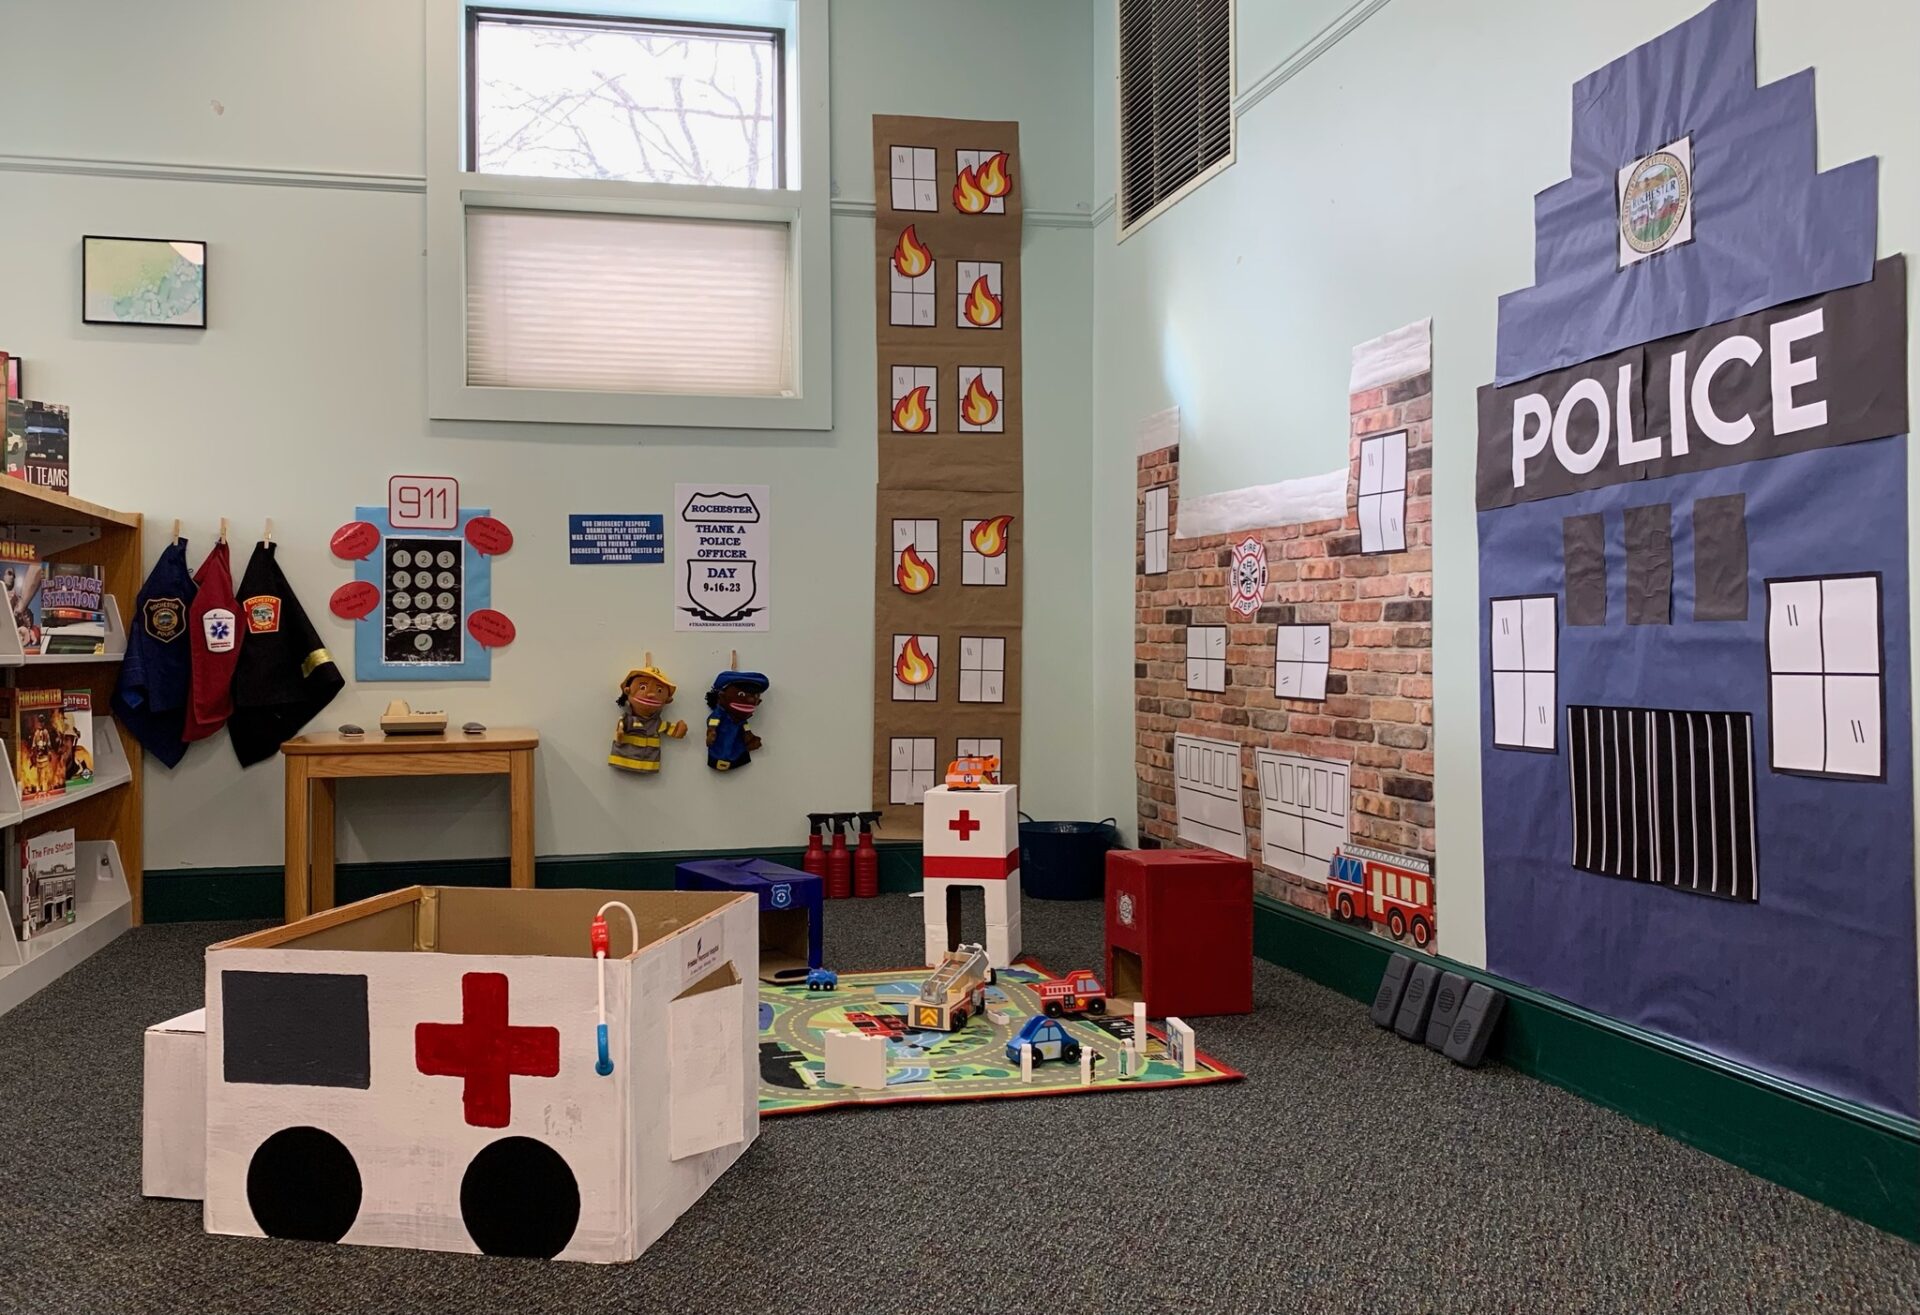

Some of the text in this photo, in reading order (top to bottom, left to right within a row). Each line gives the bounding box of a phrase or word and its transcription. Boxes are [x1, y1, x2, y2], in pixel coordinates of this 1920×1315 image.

[1512, 308, 1828, 488] POLICE
[36, 466, 68, 487] TEAMS
[399, 486, 447, 519] 911
[691, 504, 753, 514] ROCHESTER
[695, 525, 746, 534] THANK A
[700, 536, 741, 546] POLICE
[0, 541, 35, 560] OLICE
[697, 549, 747, 558] OFFICER
[1243, 543, 1257, 553] FIRE
[400, 554, 449, 563] 1 2 3
[707, 567, 737, 579] DAY
[54, 575, 103, 593] POLICE
[399, 575, 449, 585] 4 5 6
[42, 590, 101, 609] STATION
[420, 596, 427, 605] 8
[442, 596, 449, 605] 9
[150, 601, 179, 610] ROCHESTER
[1238, 600, 1254, 611] DEPT
[18, 688, 62, 706] FIREFIGHTER
[63, 696, 88, 707] ghters
[31, 842, 74, 859] The Fire Station
